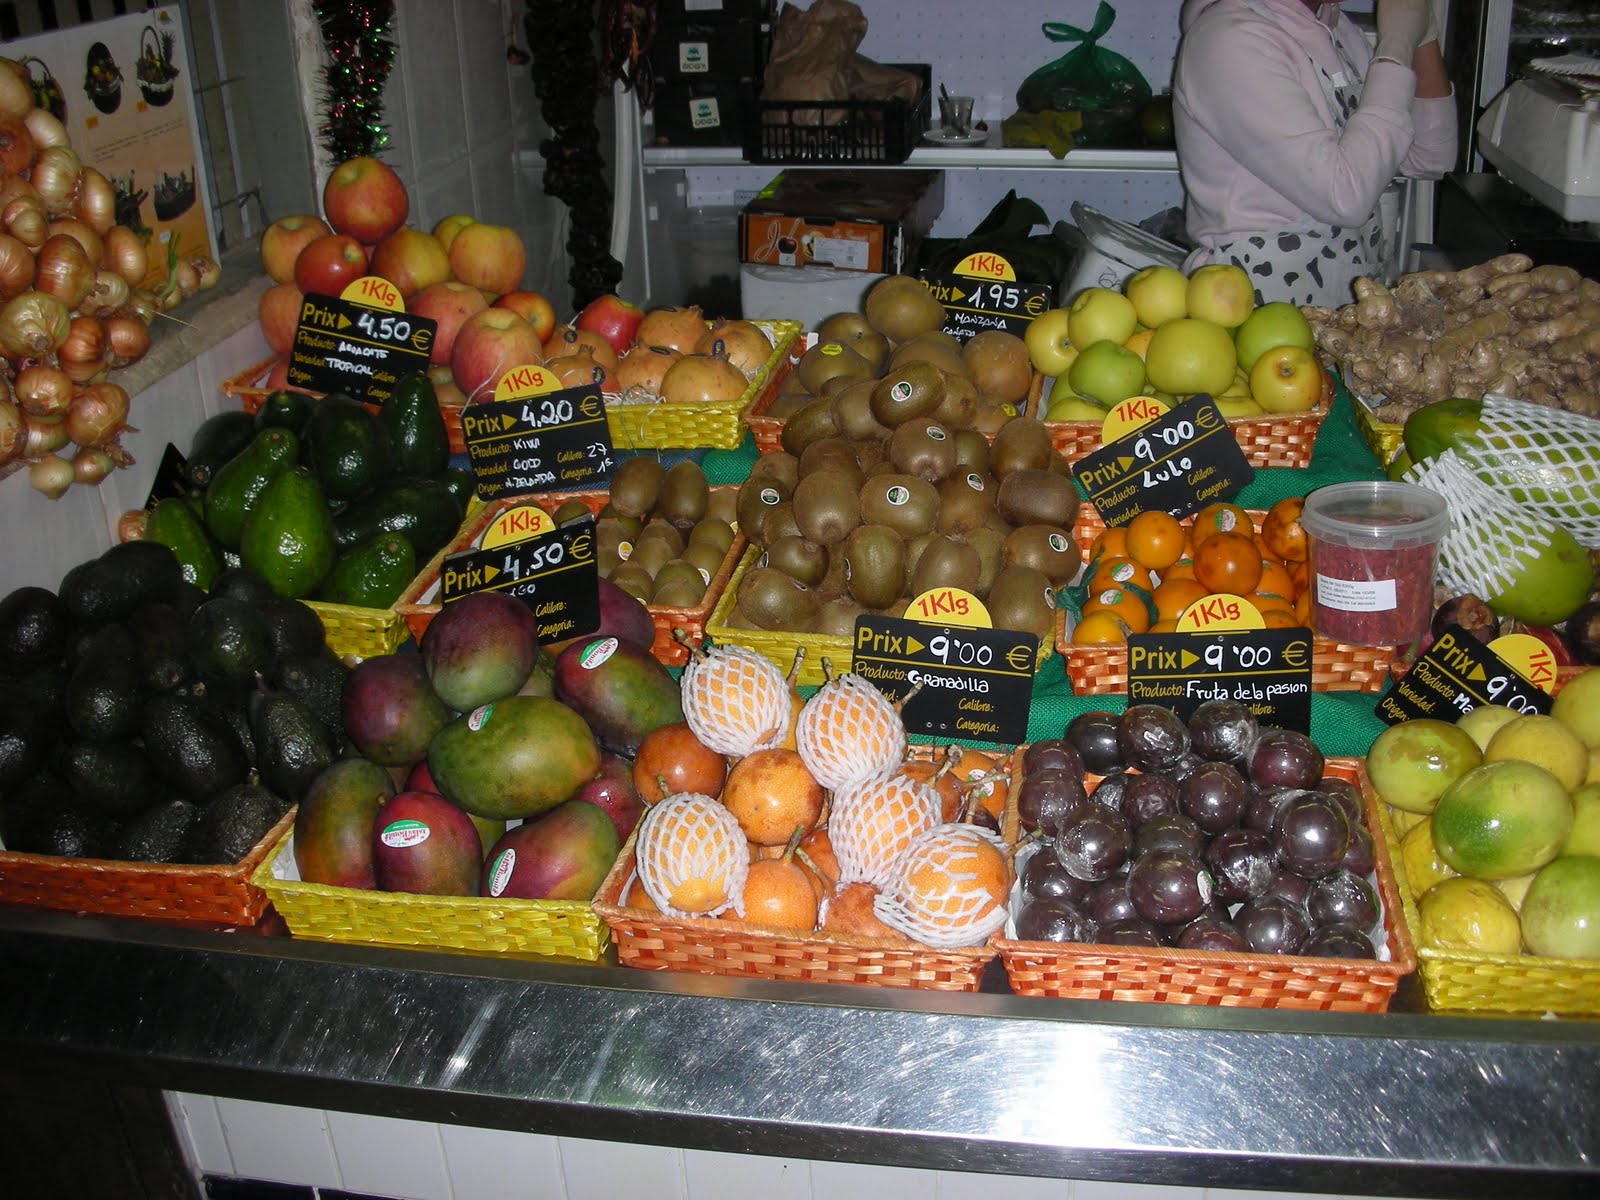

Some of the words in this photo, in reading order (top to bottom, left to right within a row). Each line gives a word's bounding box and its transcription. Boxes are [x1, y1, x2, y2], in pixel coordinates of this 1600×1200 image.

[969, 256, 1004, 276] 1Klg
[361, 280, 396, 307] 1Klg
[302, 303, 336, 328] Prix
[357, 313, 411, 341] 4.50
[955, 313, 1007, 329] MANZANA
[325, 357, 374, 375] TROPICAL
[503, 368, 544, 392] 1Klg
[464, 414, 501, 437] Prix
[521, 399, 572, 427] 4.20
[1116, 400, 1159, 422] 1Klg
[1080, 460, 1121, 491] Prix
[1095, 485, 1139, 512] Producto:
[499, 510, 541, 535] 1Klg
[445, 567, 481, 594] Prix
[536, 601, 567, 617] Calibre:
[918, 591, 969, 617] 1Klg
[1189, 598, 1240, 628] 1Klg
[858, 627, 902, 654] Prix
[1131, 646, 1176, 670] Prix
[1432, 633, 1474, 675] Prix
[855, 661, 908, 680] Producto:
[1413, 662, 1455, 700] Producto:
[1131, 682, 1185, 698] Producto:
[1187, 681, 1228, 700] Fruta
[959, 698, 994, 712] Calibre:
[957, 718, 999, 735] Categoria:
